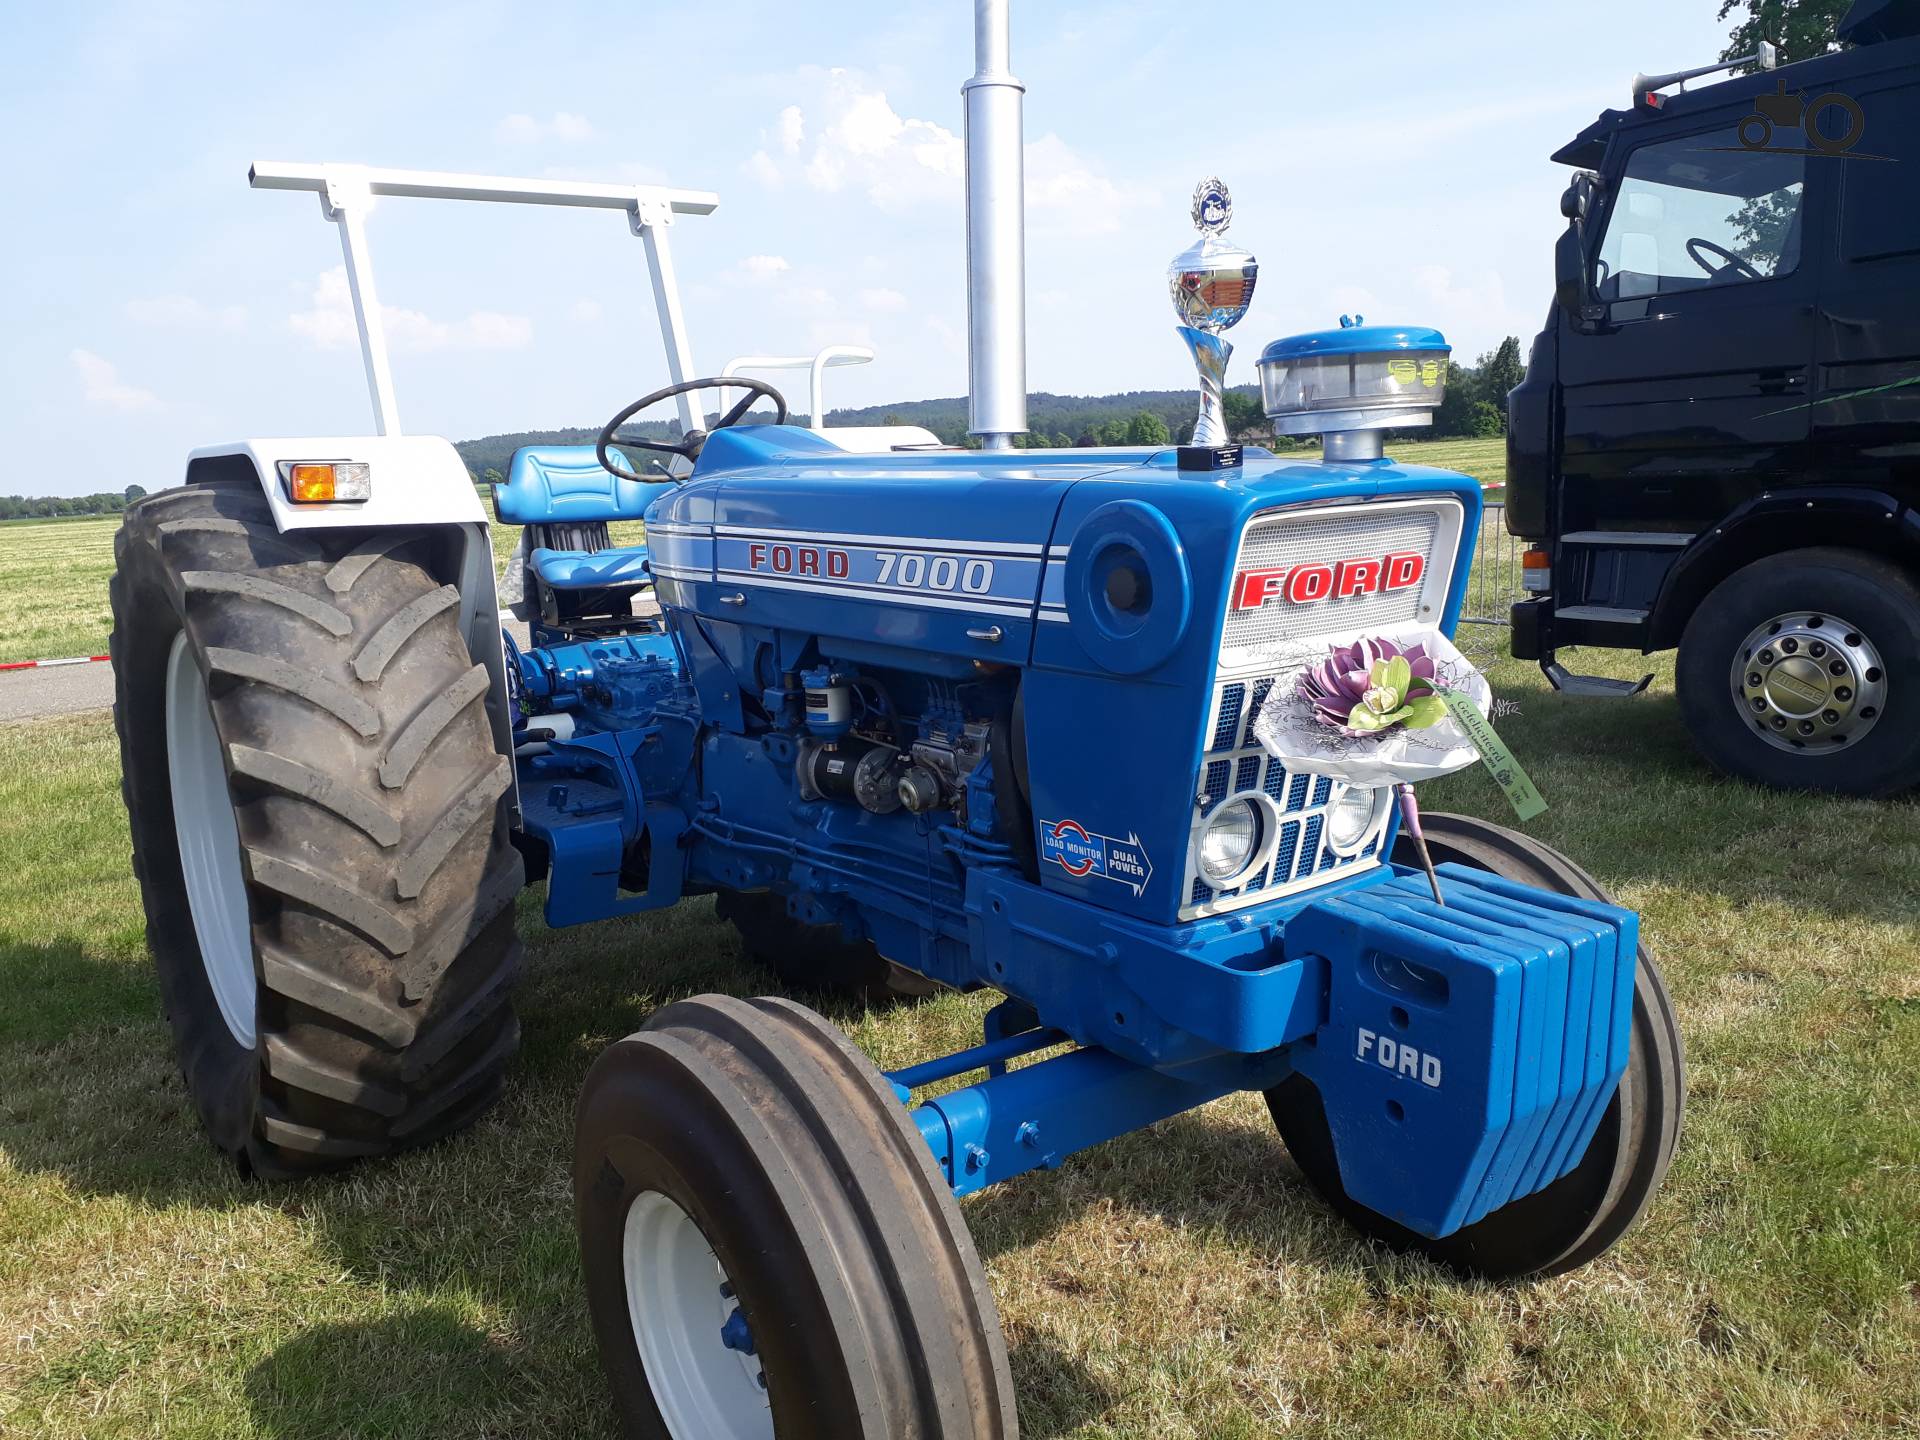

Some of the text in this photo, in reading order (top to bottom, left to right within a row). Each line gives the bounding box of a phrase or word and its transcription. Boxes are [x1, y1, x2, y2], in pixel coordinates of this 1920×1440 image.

[749, 543, 995, 595] FORD 7000
[1233, 551, 1425, 611] FORD
[1457, 700, 1506, 763] Gefeliciteerd
[1045, 836, 1102, 861] LOAD MONITOR
[1109, 859, 1144, 877] POWER
[1113, 849, 1139, 865] DUAL
[1357, 1027, 1441, 1088] FORD
